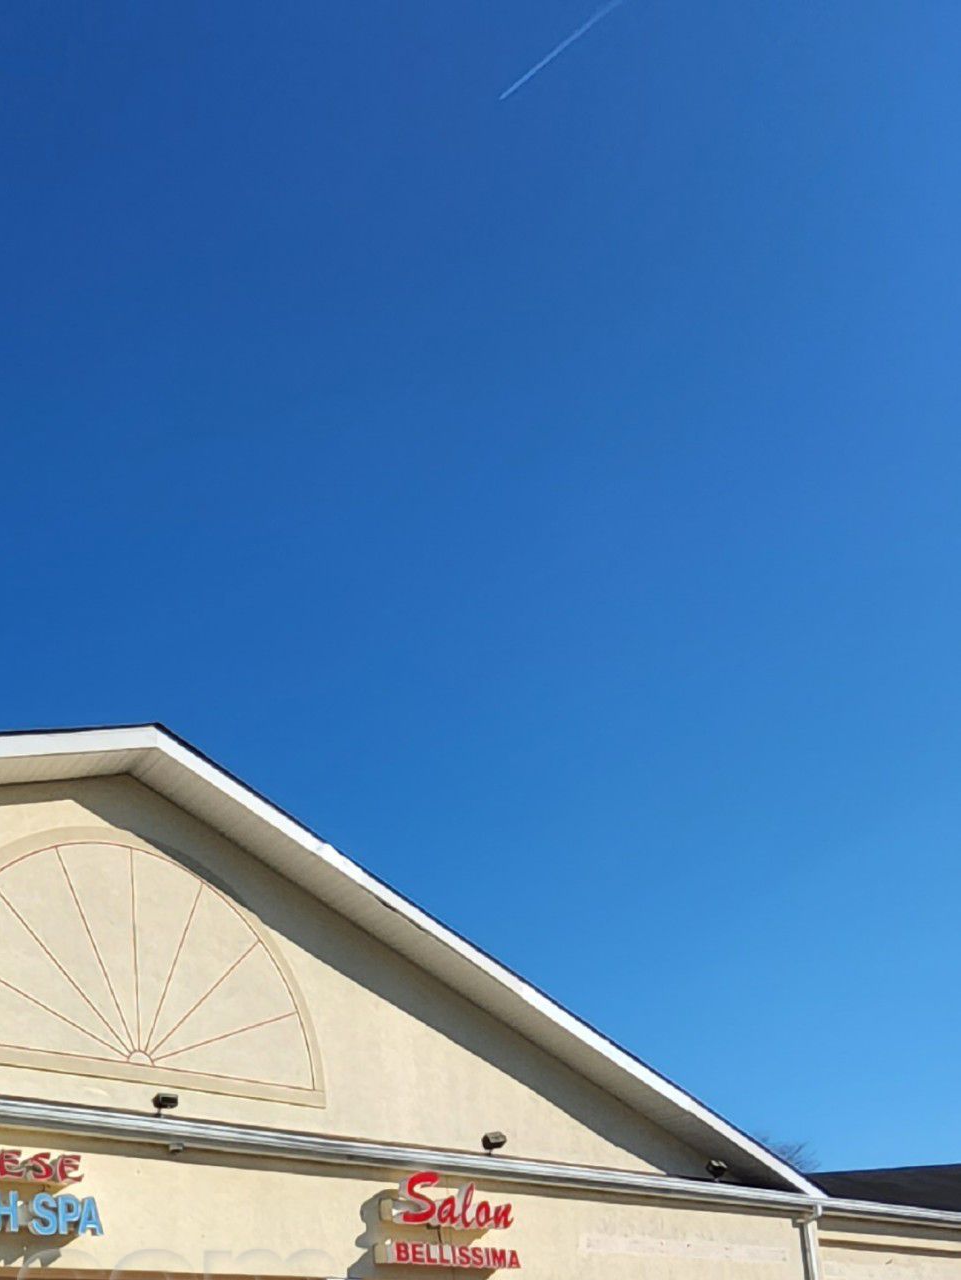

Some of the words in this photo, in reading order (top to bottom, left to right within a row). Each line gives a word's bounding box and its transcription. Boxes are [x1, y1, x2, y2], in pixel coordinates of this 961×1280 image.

[28, 1193, 104, 1236] SPA
[401, 1170, 515, 1230] Salon
[394, 1241, 522, 1269] BELLISSIMA
